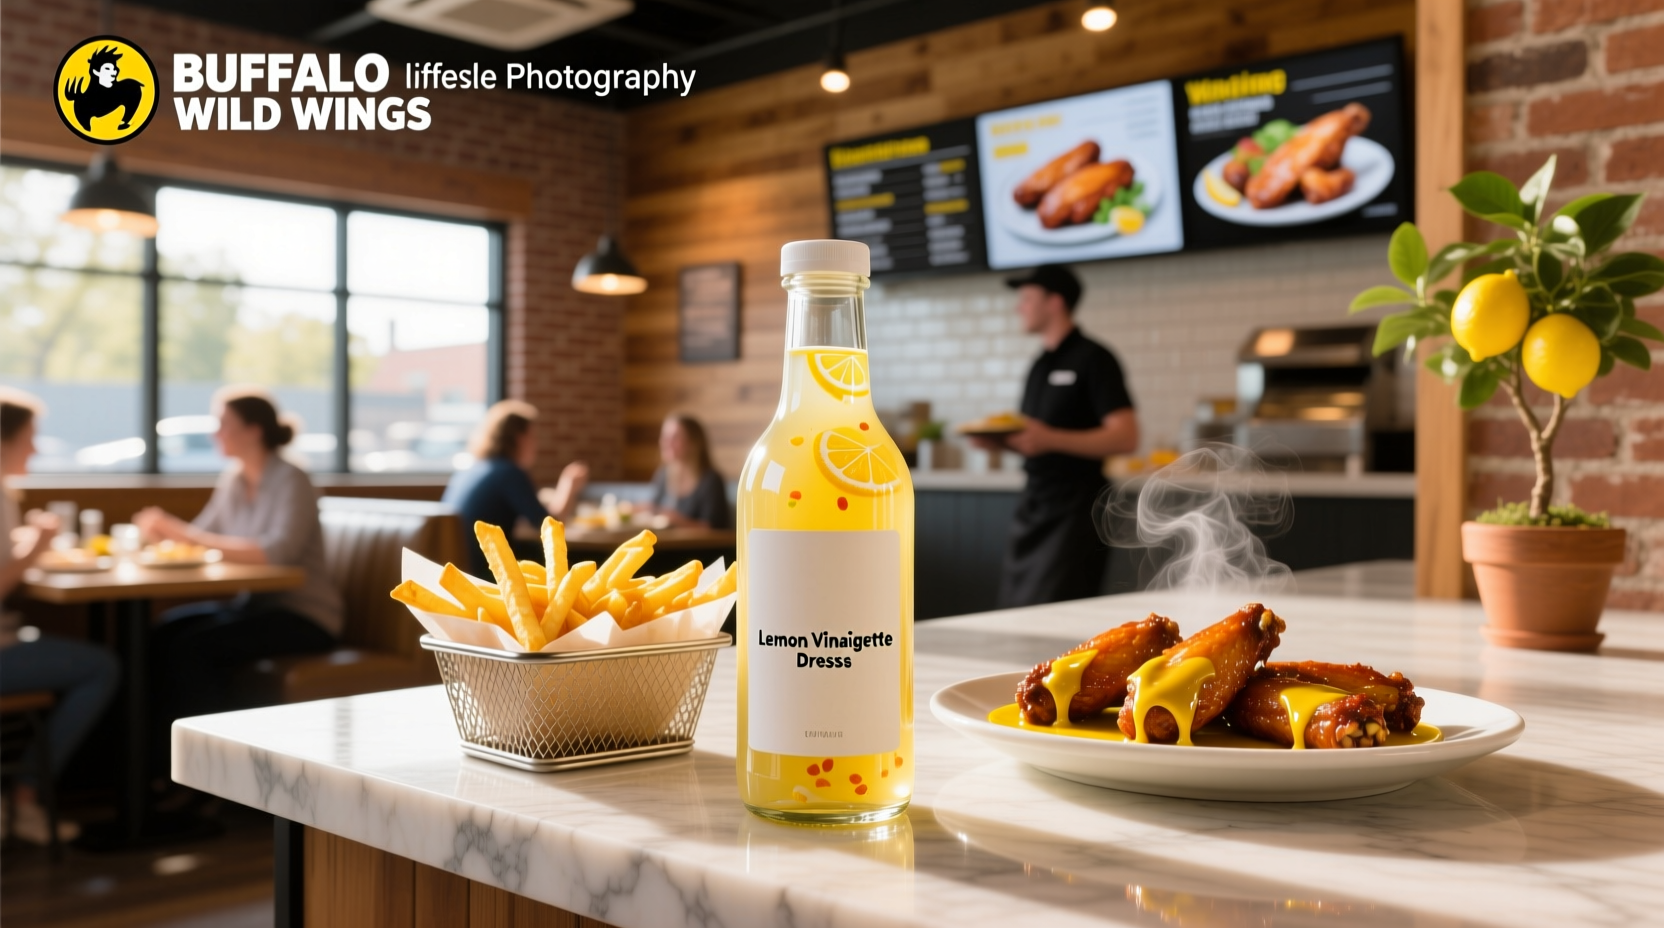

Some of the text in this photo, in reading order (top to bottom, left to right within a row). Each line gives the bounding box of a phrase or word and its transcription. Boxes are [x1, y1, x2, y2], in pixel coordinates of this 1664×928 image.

[758, 629, 893, 653] Lemon Vinaigette
[796, 652, 852, 669] Dresss
